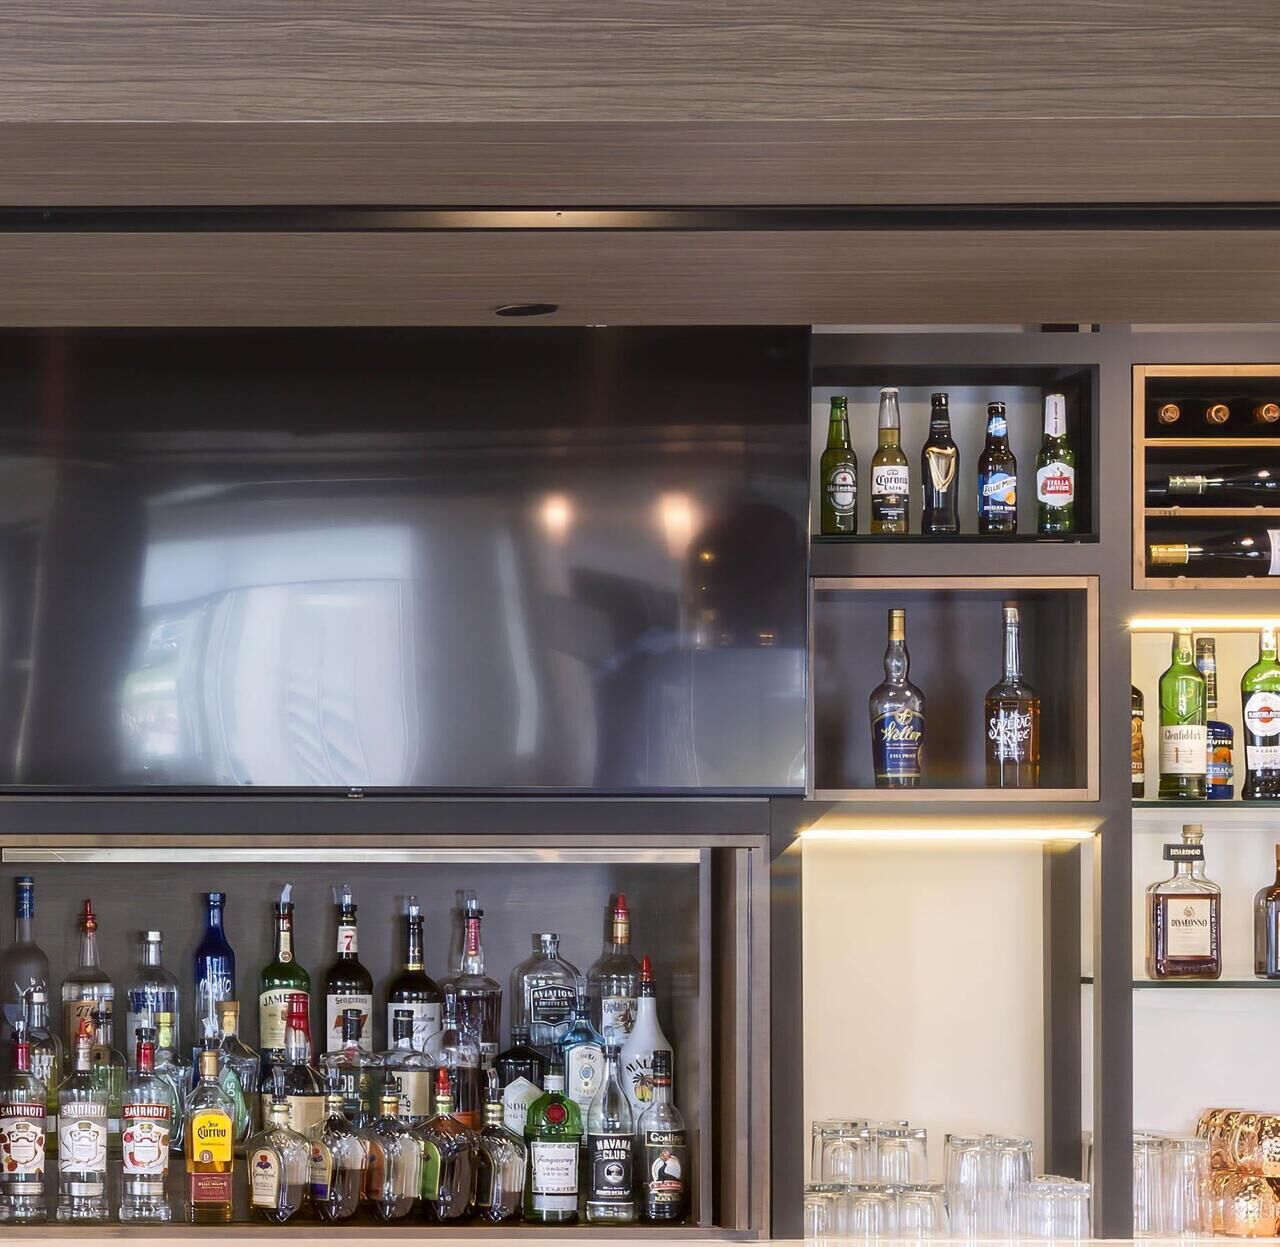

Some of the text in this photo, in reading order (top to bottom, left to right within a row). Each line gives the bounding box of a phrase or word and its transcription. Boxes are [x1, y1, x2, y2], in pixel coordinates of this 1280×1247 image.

[344, 935, 353, 951] 7
[263, 994, 290, 1007] JAME
[124, 1105, 167, 1117] SMIRNOFF
[505, 1102, 528, 1110] NDR
[596, 1139, 631, 1150] HAVANA
[602, 1150, 626, 1160] CLUB
